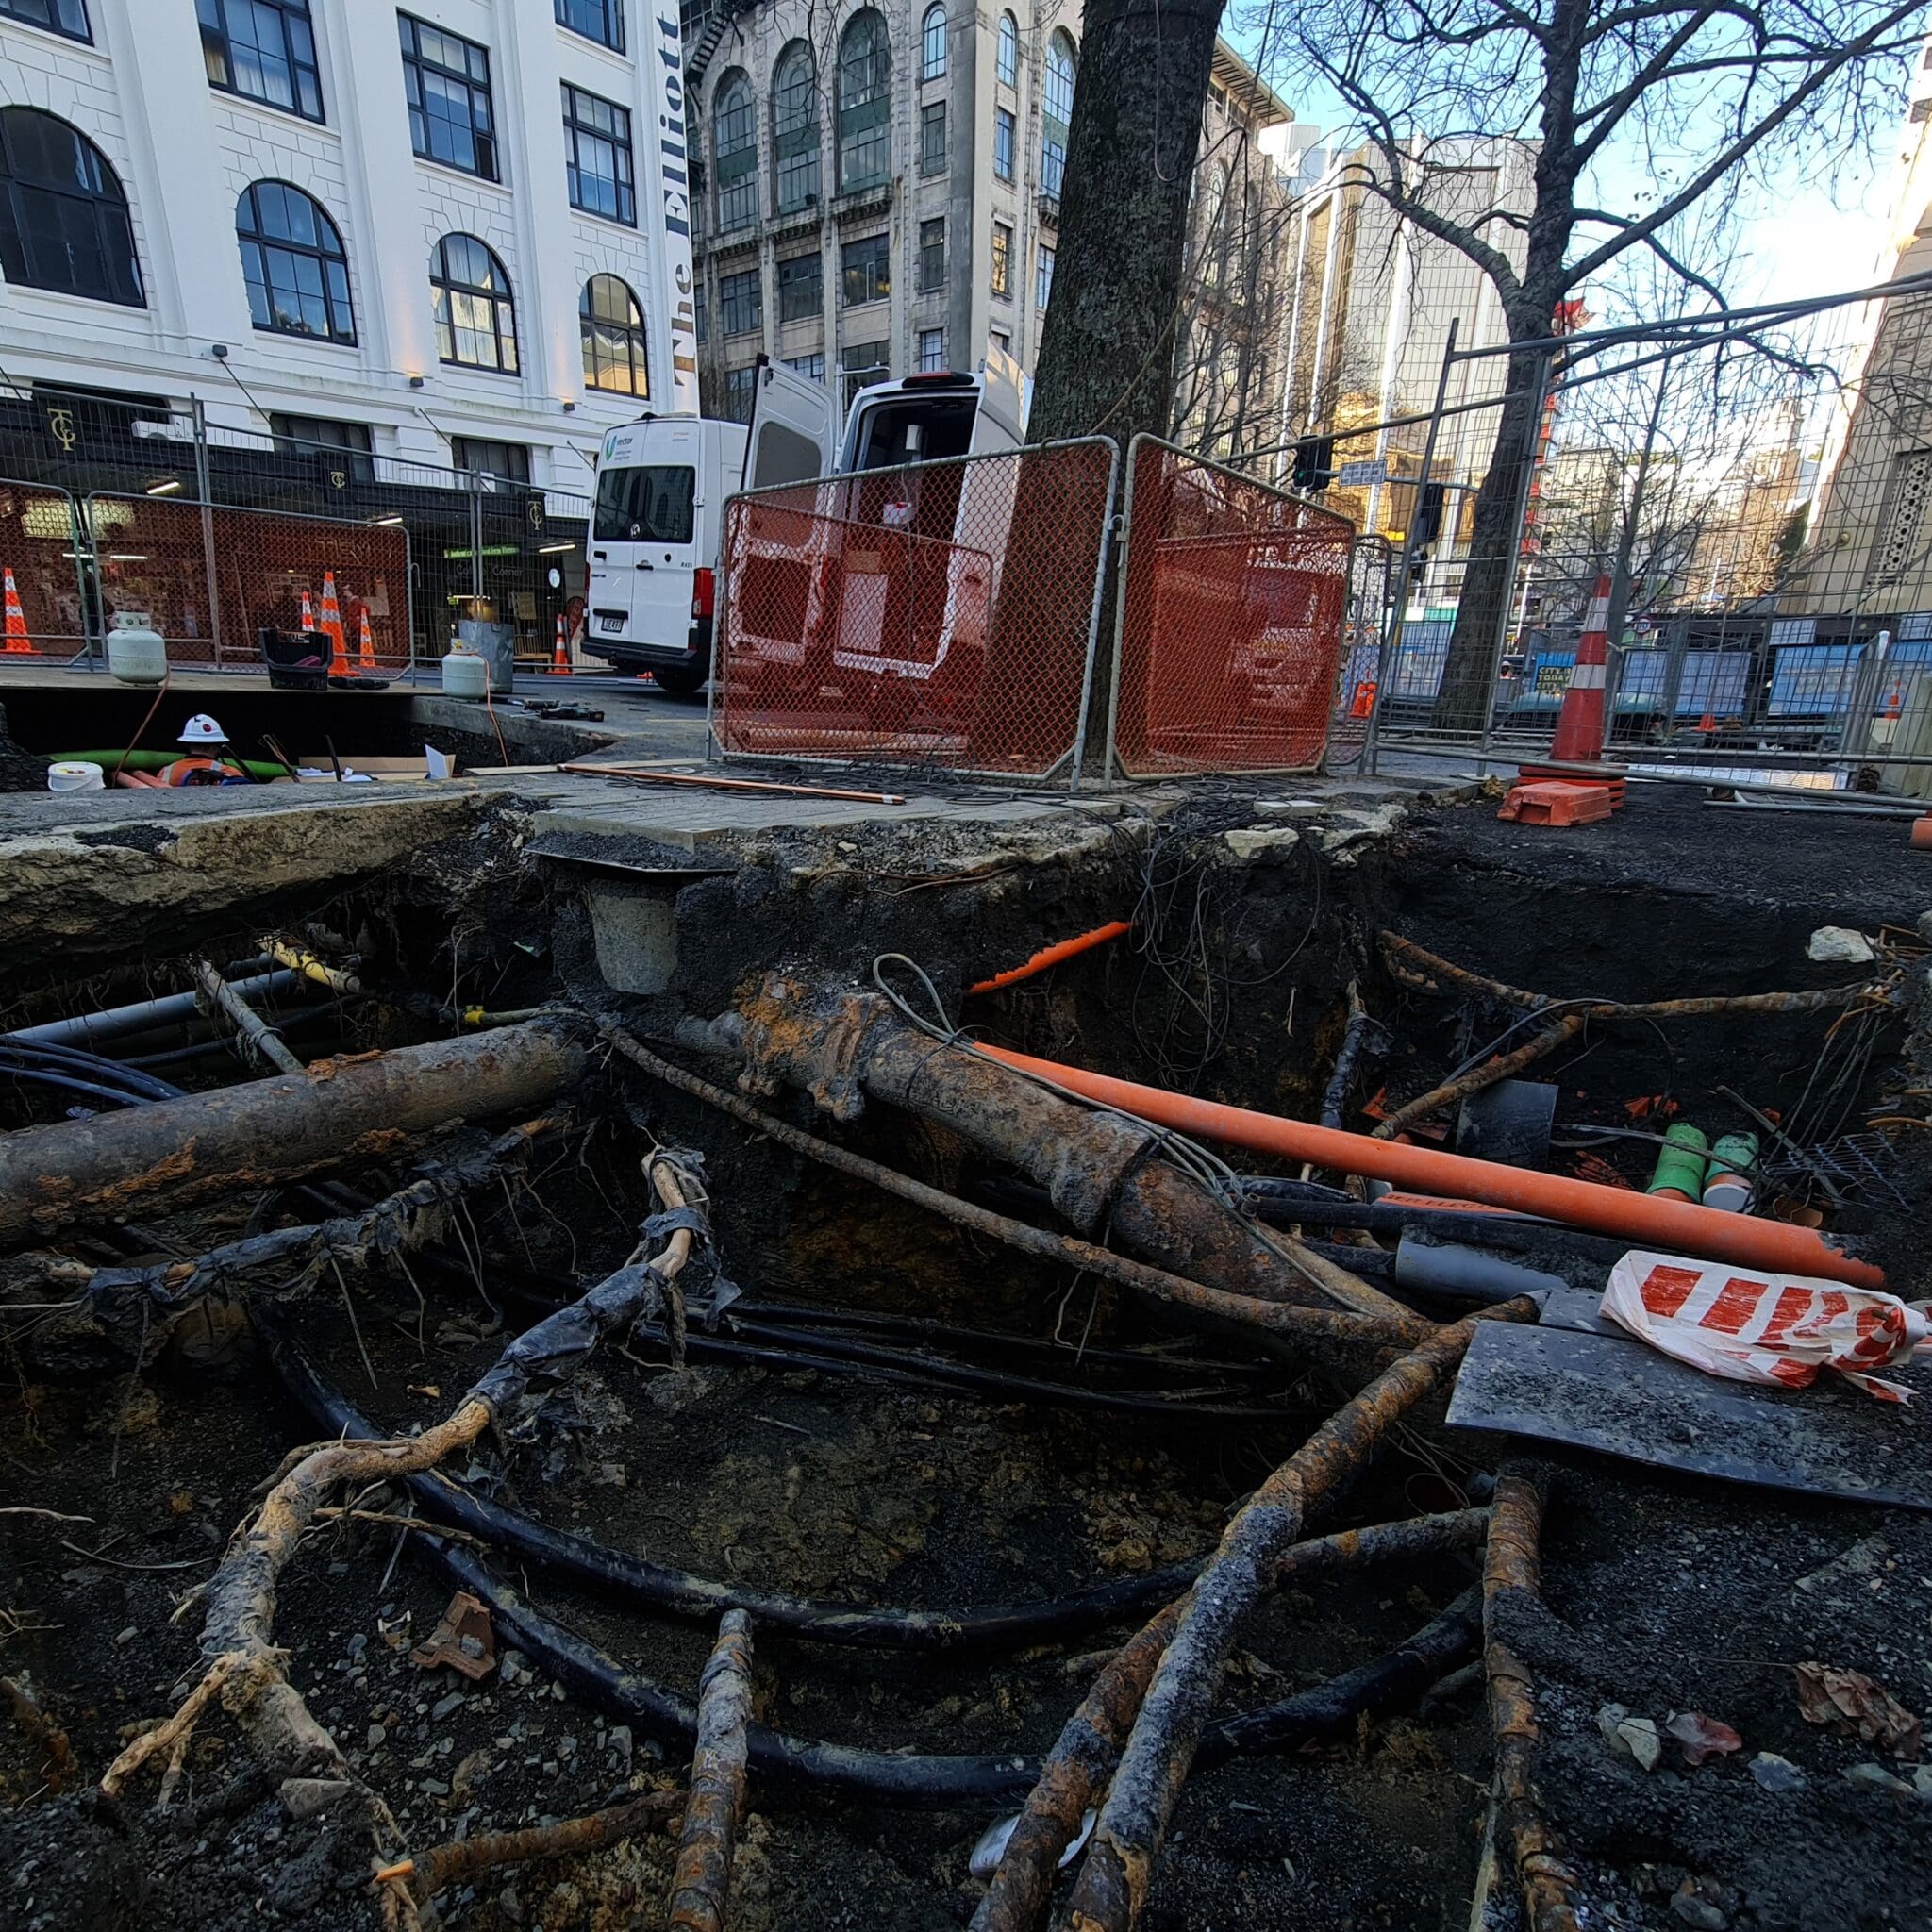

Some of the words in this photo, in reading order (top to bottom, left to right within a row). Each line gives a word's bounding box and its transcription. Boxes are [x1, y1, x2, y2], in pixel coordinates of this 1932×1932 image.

[656, 9, 690, 245] Elliott
[671, 263, 696, 387] The
[1539, 666, 1560, 675] CITY
